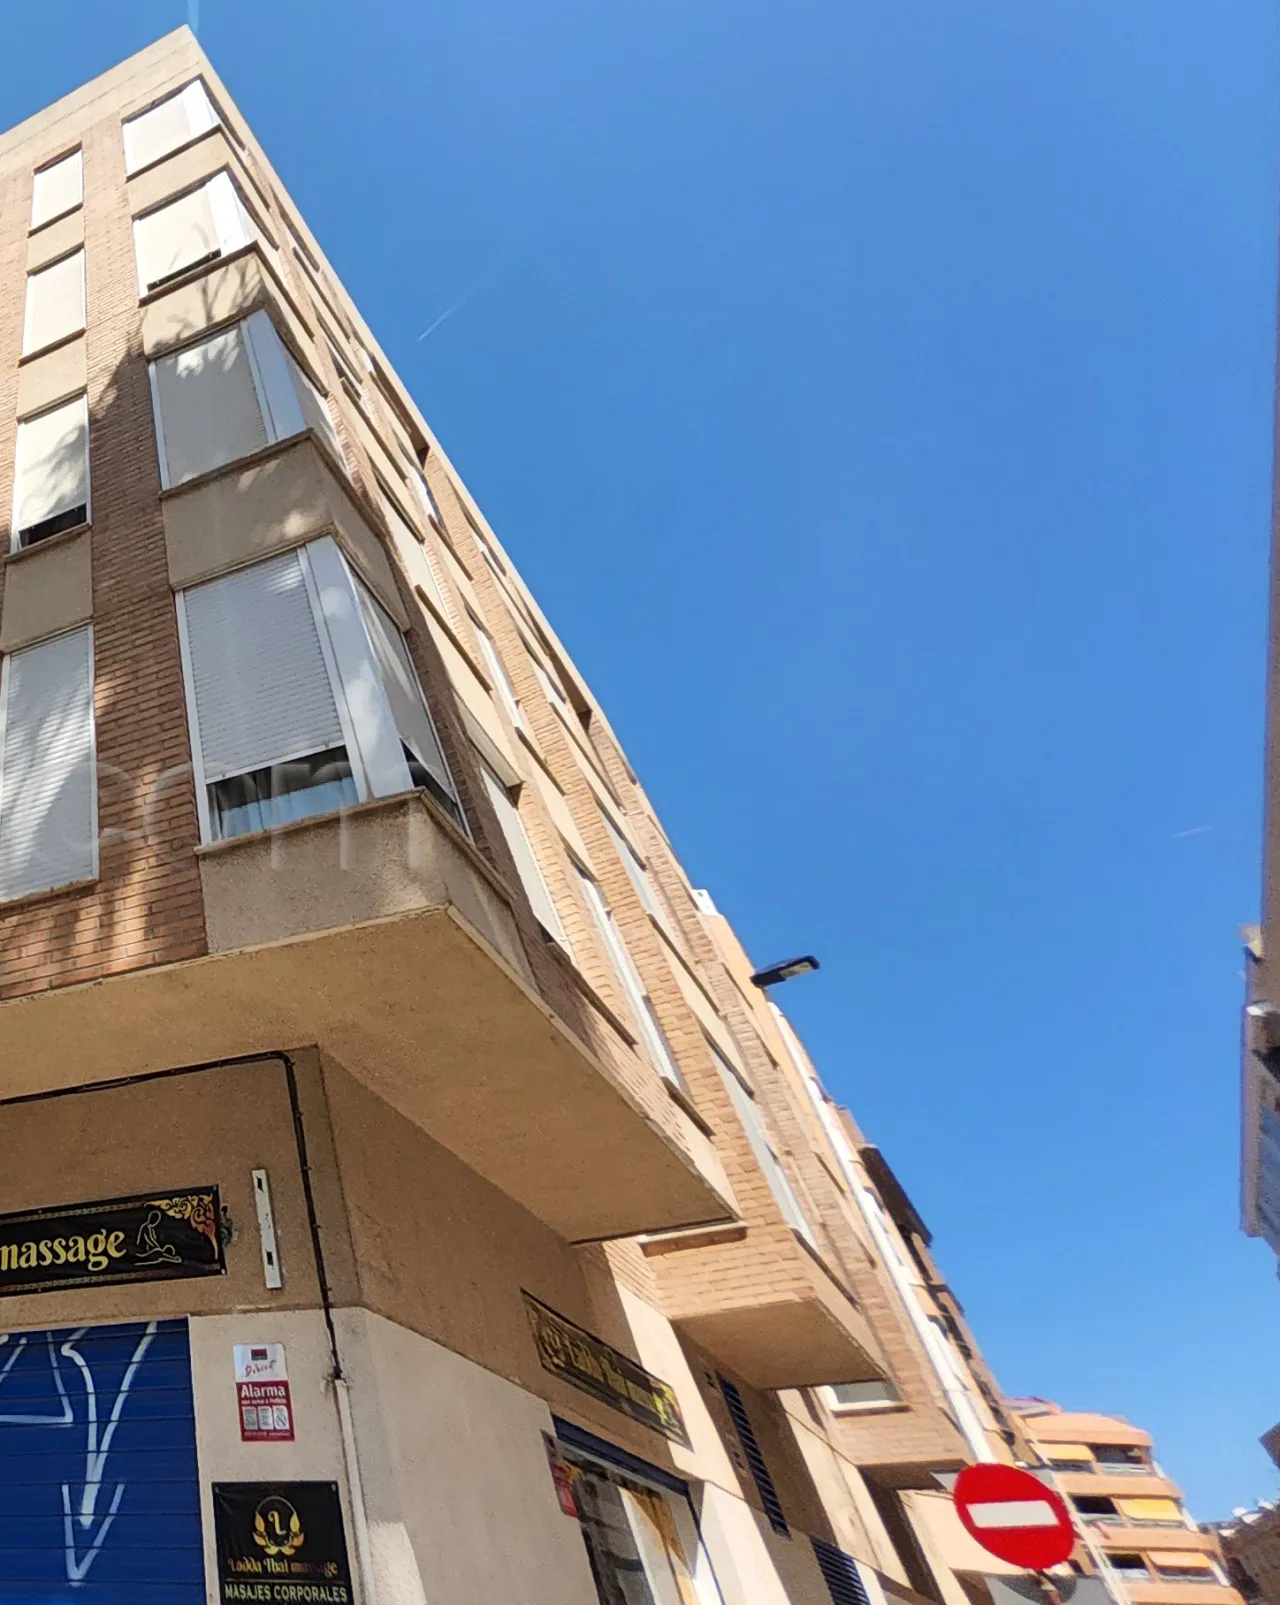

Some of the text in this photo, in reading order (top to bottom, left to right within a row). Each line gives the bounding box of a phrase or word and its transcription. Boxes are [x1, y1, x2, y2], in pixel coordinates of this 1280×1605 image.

[241, 1384, 286, 1398] Alarma
[227, 1556, 338, 1579] Ladda Thai masge
[225, 1584, 348, 1602] MASAJES CORPORALES
